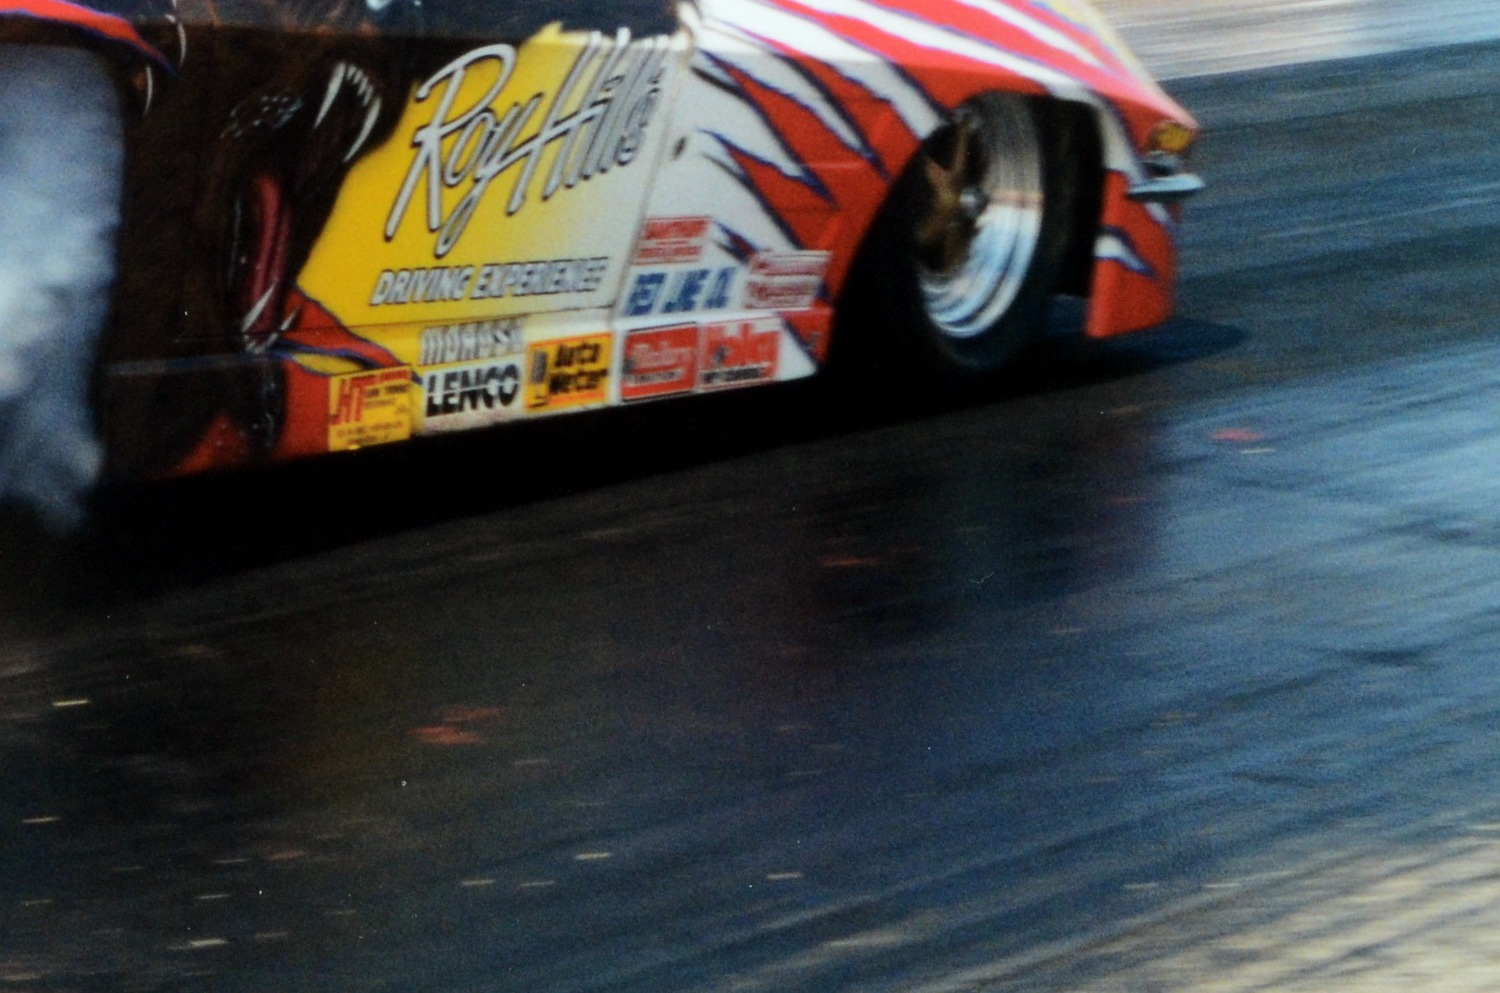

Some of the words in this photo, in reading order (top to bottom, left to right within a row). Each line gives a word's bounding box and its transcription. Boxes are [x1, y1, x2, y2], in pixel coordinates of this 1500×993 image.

[369, 264, 475, 307] DRIVING
[470, 257, 609, 301] EXPERIENCE
[555, 342, 603, 368] Auto
[425, 363, 520, 418] LENCO
